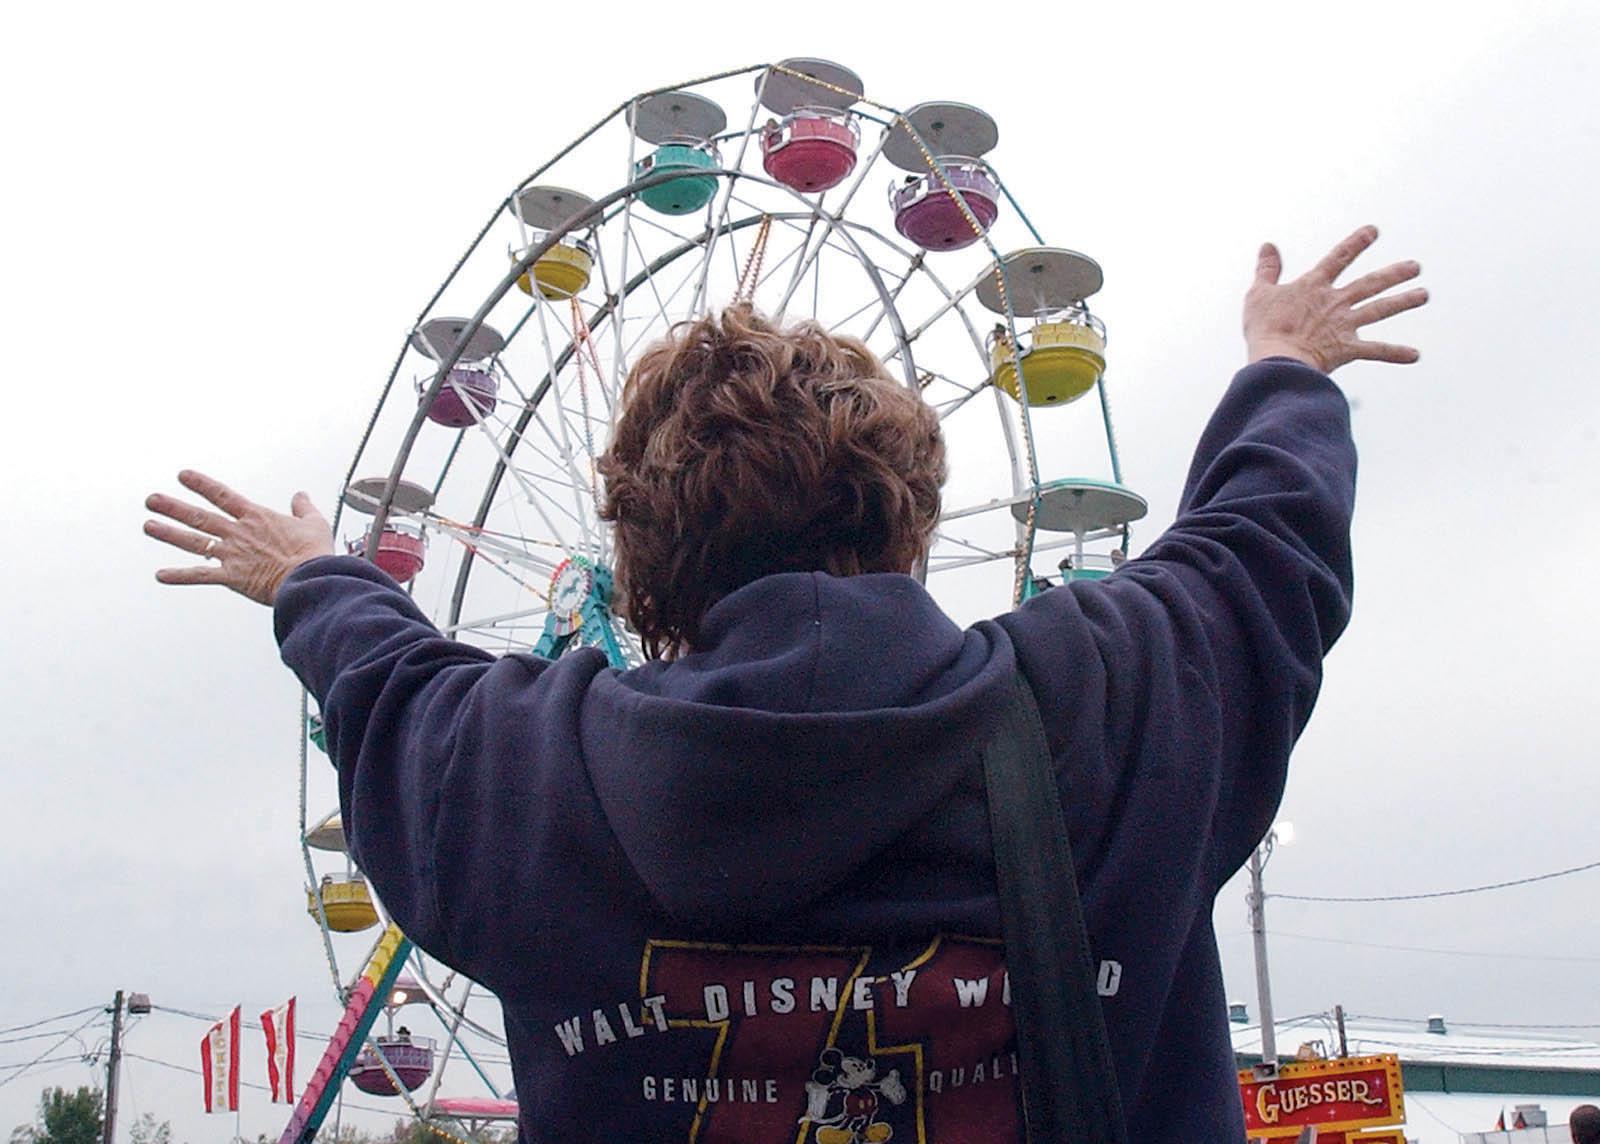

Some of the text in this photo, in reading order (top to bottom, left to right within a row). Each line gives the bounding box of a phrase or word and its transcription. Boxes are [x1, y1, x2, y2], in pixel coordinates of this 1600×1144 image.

[554, 994, 669, 1056] WALT
[703, 969, 917, 1022] DISNEY
[643, 1052, 1019, 1103] GENUINE QUALI
[1256, 1079, 1383, 1124] GUESSER
